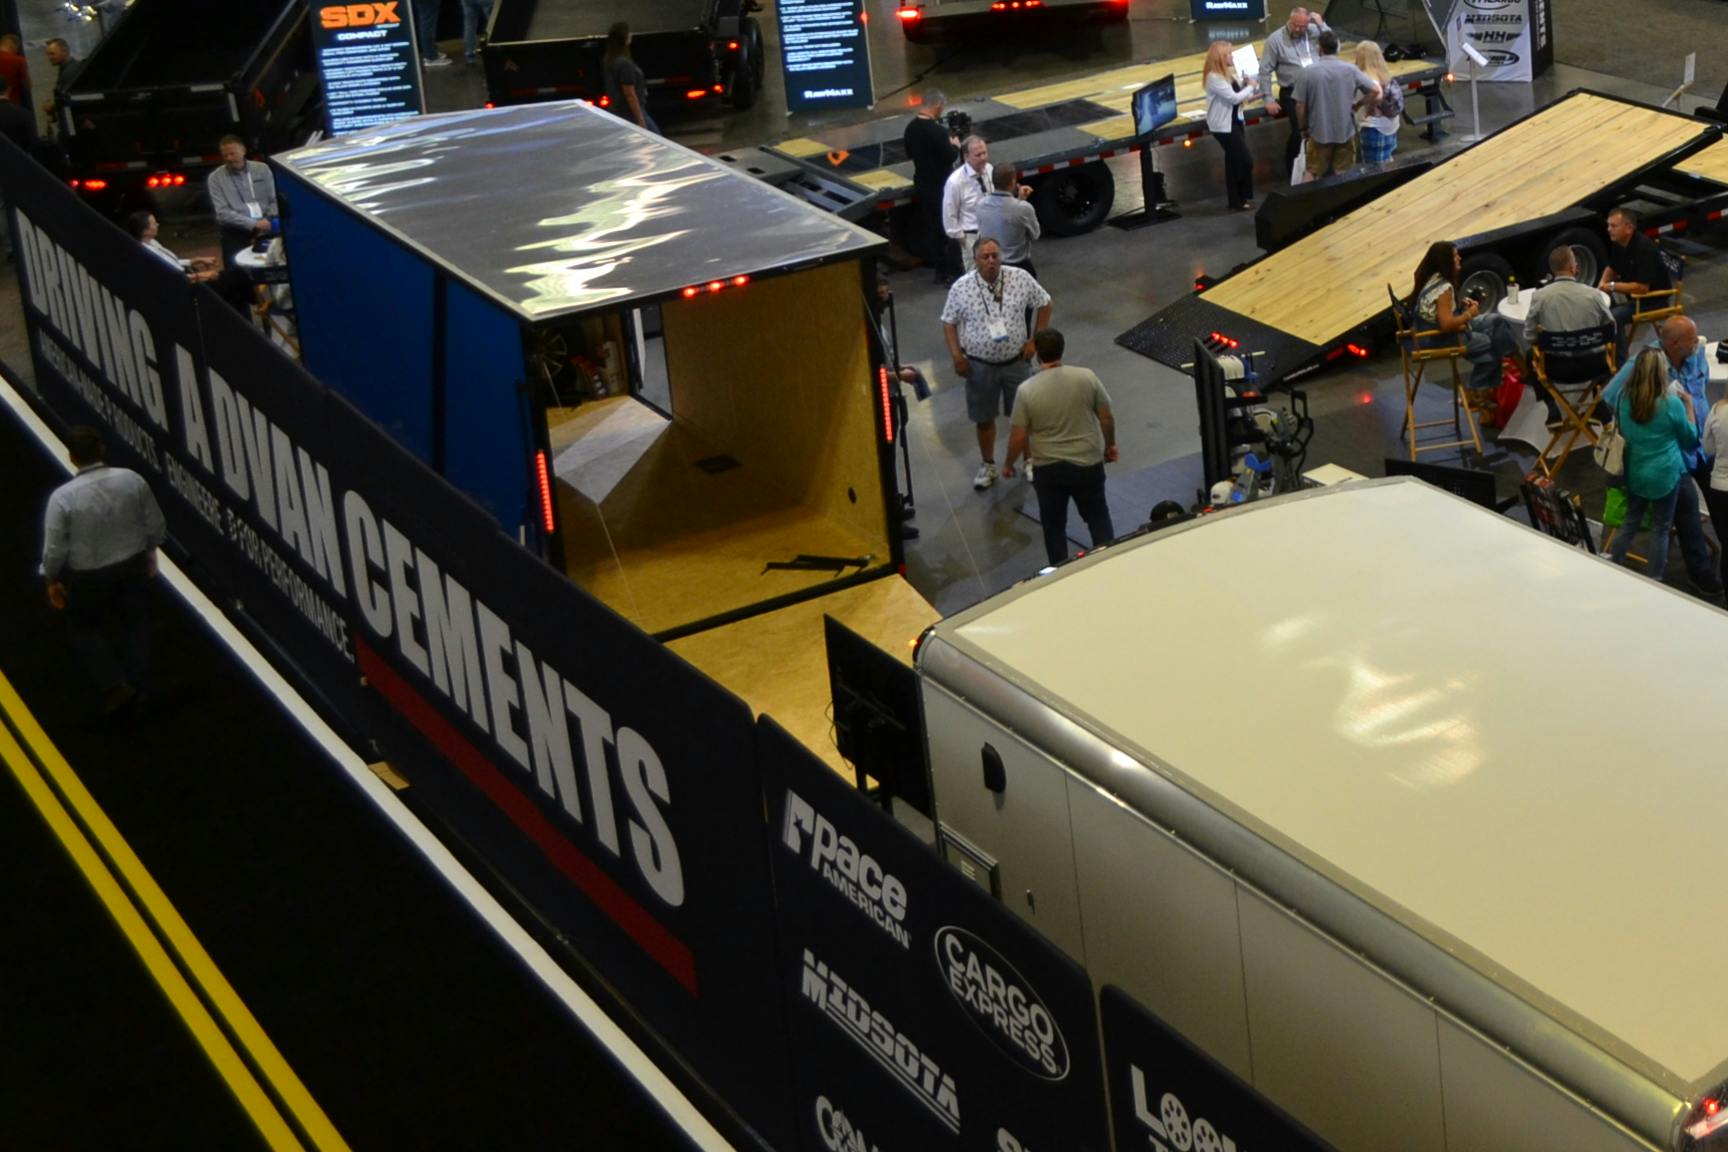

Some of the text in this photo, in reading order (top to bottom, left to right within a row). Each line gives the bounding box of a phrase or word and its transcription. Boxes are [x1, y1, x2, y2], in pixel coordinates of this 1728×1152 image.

[320, 1, 402, 29] SDX
[336, 29, 388, 41] COMPACT
[15, 207, 169, 432] DRIVING
[823, 864, 910, 949] AMERICAN
[801, 948, 960, 1128] MIDSOTA
[944, 933, 1054, 1046] CARGO
[949, 965, 1060, 1075] EXPRESS
